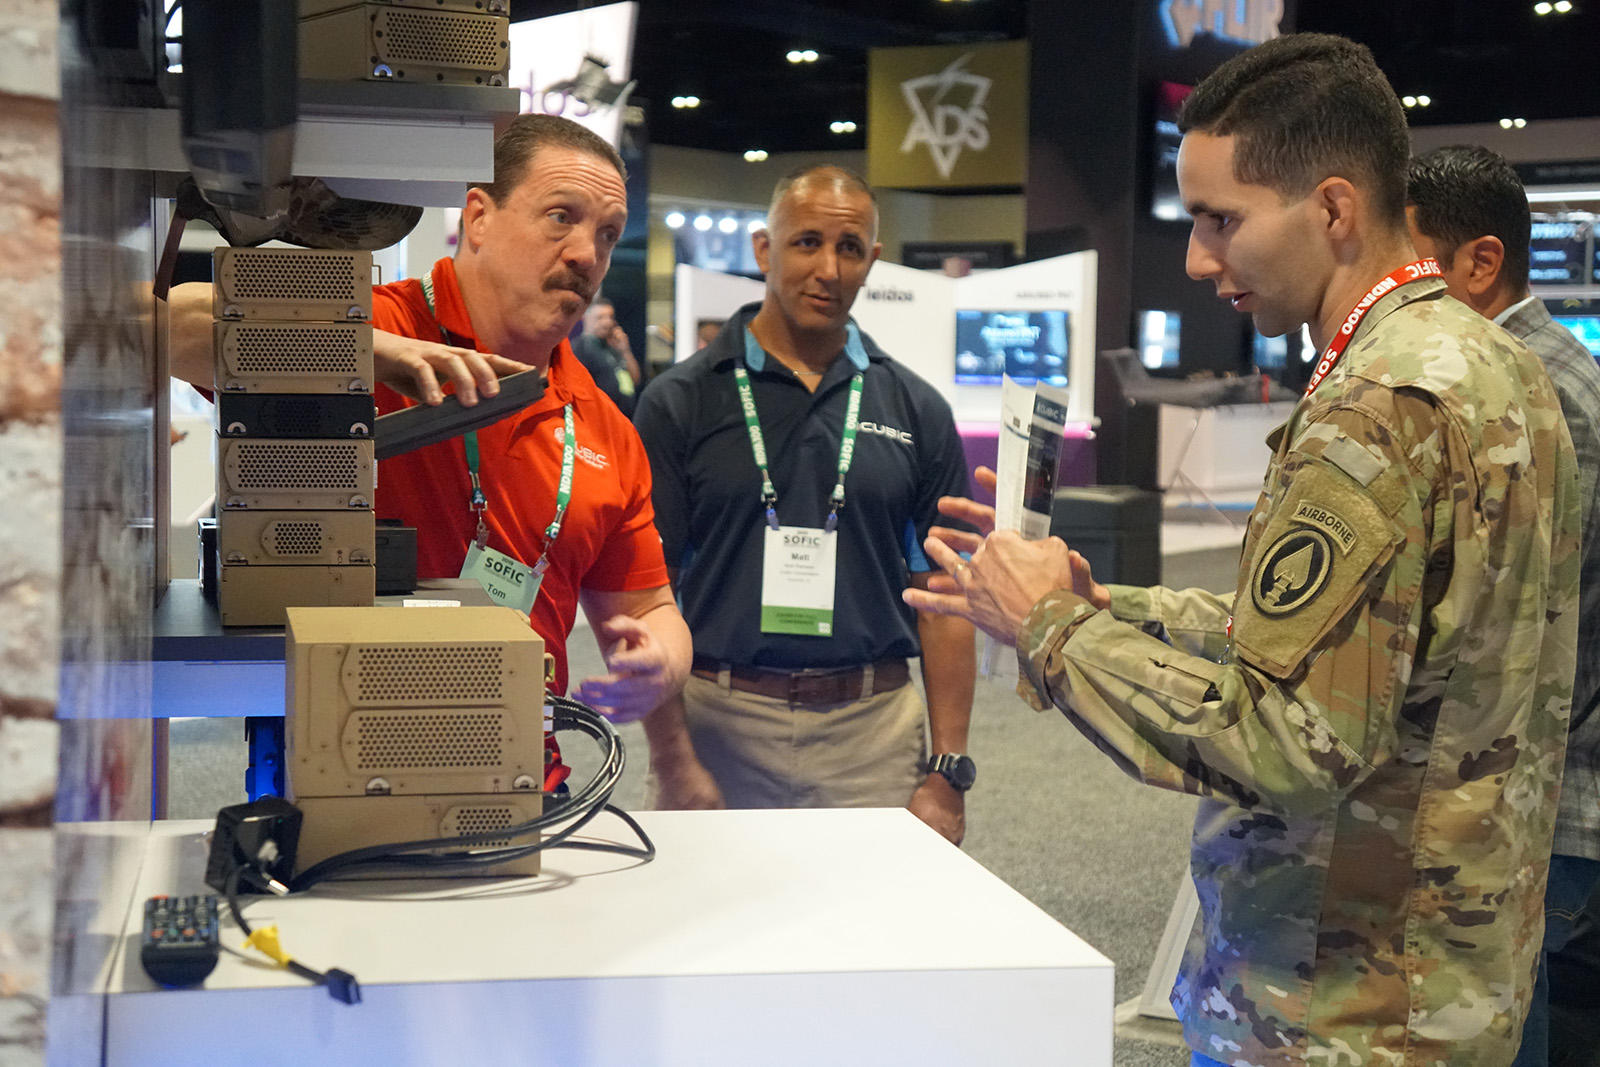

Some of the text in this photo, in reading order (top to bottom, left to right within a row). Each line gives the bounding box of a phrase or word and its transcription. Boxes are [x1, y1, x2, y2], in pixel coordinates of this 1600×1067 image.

[1304, 348, 1337, 398] SOF
[860, 421, 914, 445] CUBIC
[574, 441, 610, 467] UBIC
[1298, 506, 1353, 544] AIRBORNE
[783, 535, 820, 546] SOFIC
[484, 556, 525, 584] SOFIC
[487, 583, 506, 599] Tom
